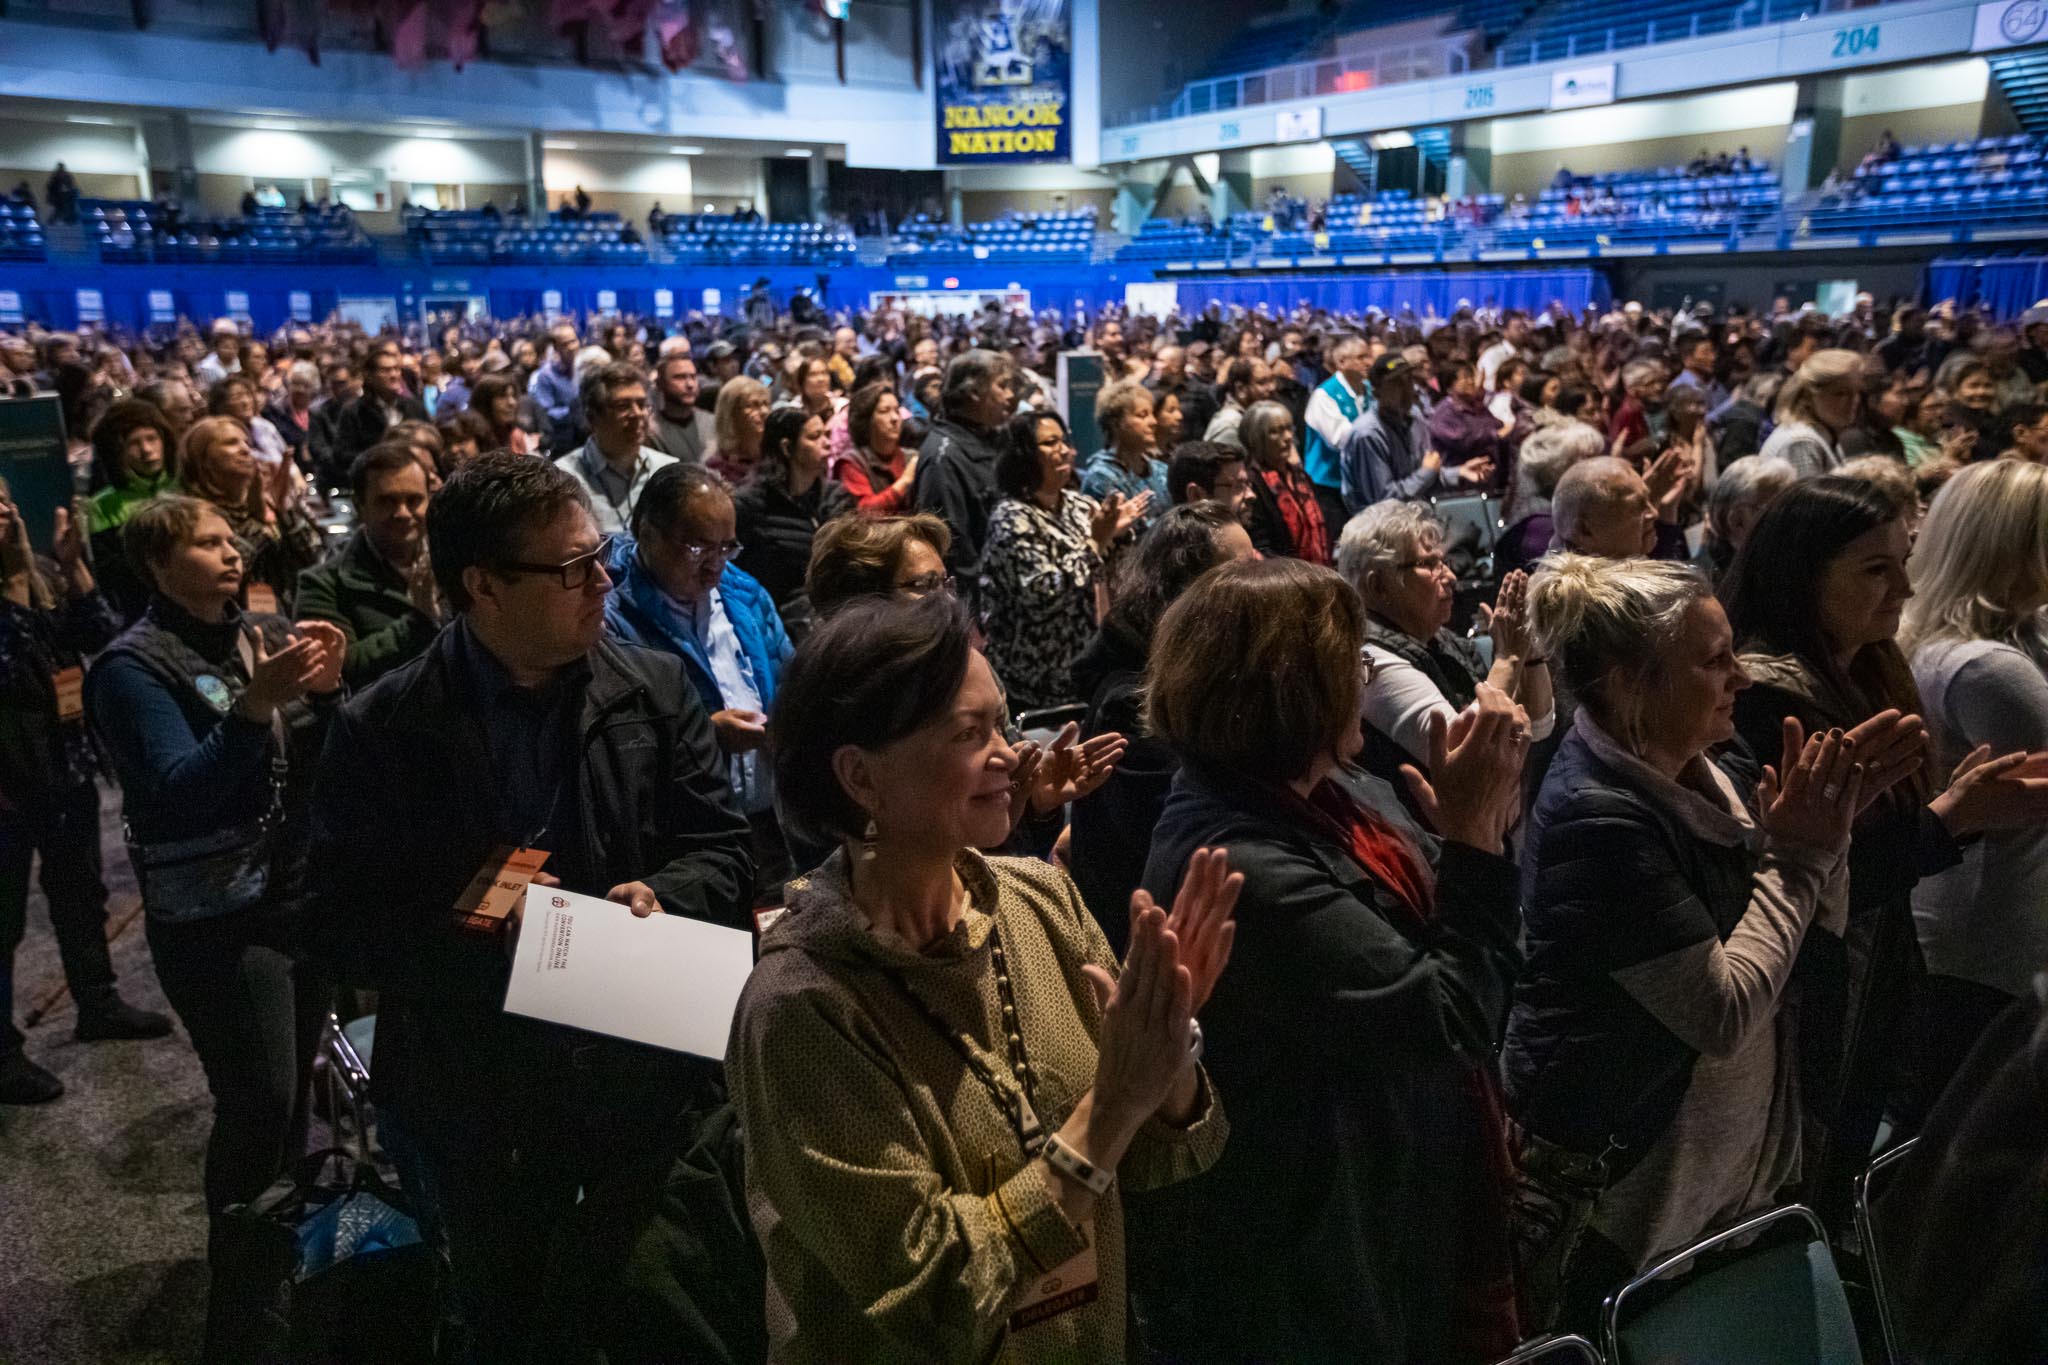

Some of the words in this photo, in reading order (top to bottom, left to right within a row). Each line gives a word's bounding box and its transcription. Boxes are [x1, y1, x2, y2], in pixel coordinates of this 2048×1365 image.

[1832, 25, 1880, 58] 204
[944, 104, 1062, 129] NANOOK
[950, 130, 1056, 154] NATION
[557, 913, 567, 946] CONVENTION
[565, 926, 573, 937] CAN
[553, 947, 562, 969] ONLINE
[562, 938, 570, 957] WATCH
